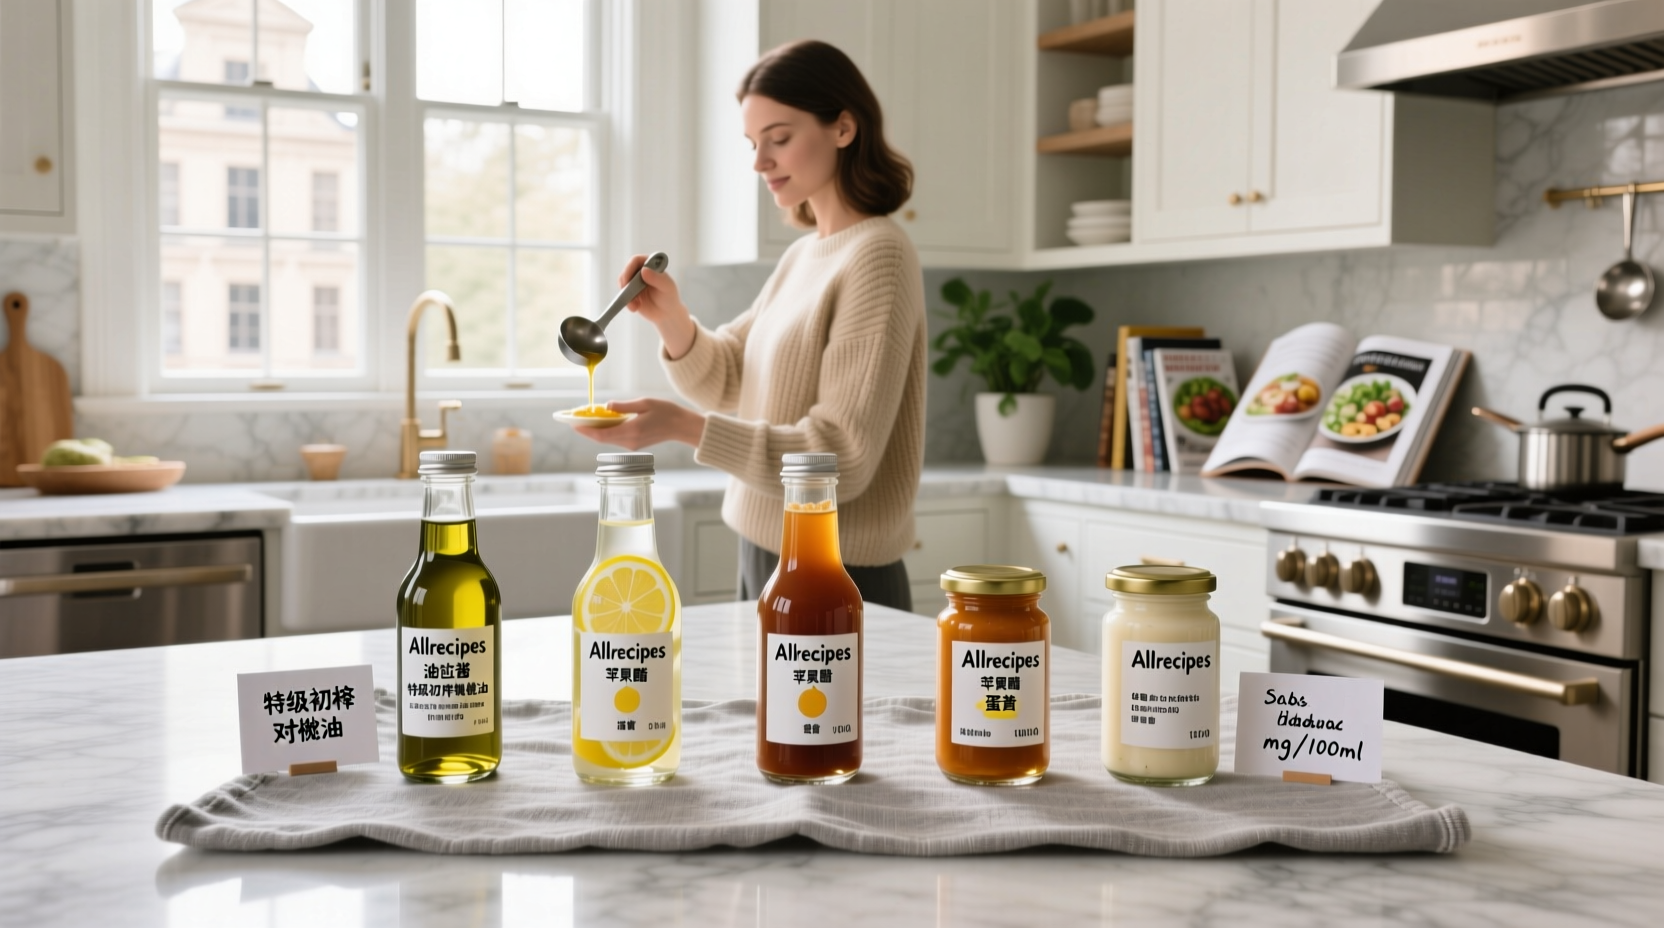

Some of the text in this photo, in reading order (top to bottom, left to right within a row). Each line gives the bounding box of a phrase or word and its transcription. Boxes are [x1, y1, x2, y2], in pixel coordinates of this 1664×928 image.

[409, 636, 486, 660] Allrecipes
[589, 641, 666, 664] Allrecipes
[961, 649, 1040, 673] Allrecipes
[1131, 649, 1211, 675] Allrecipes
[1263, 733, 1363, 761] mg/100ml
